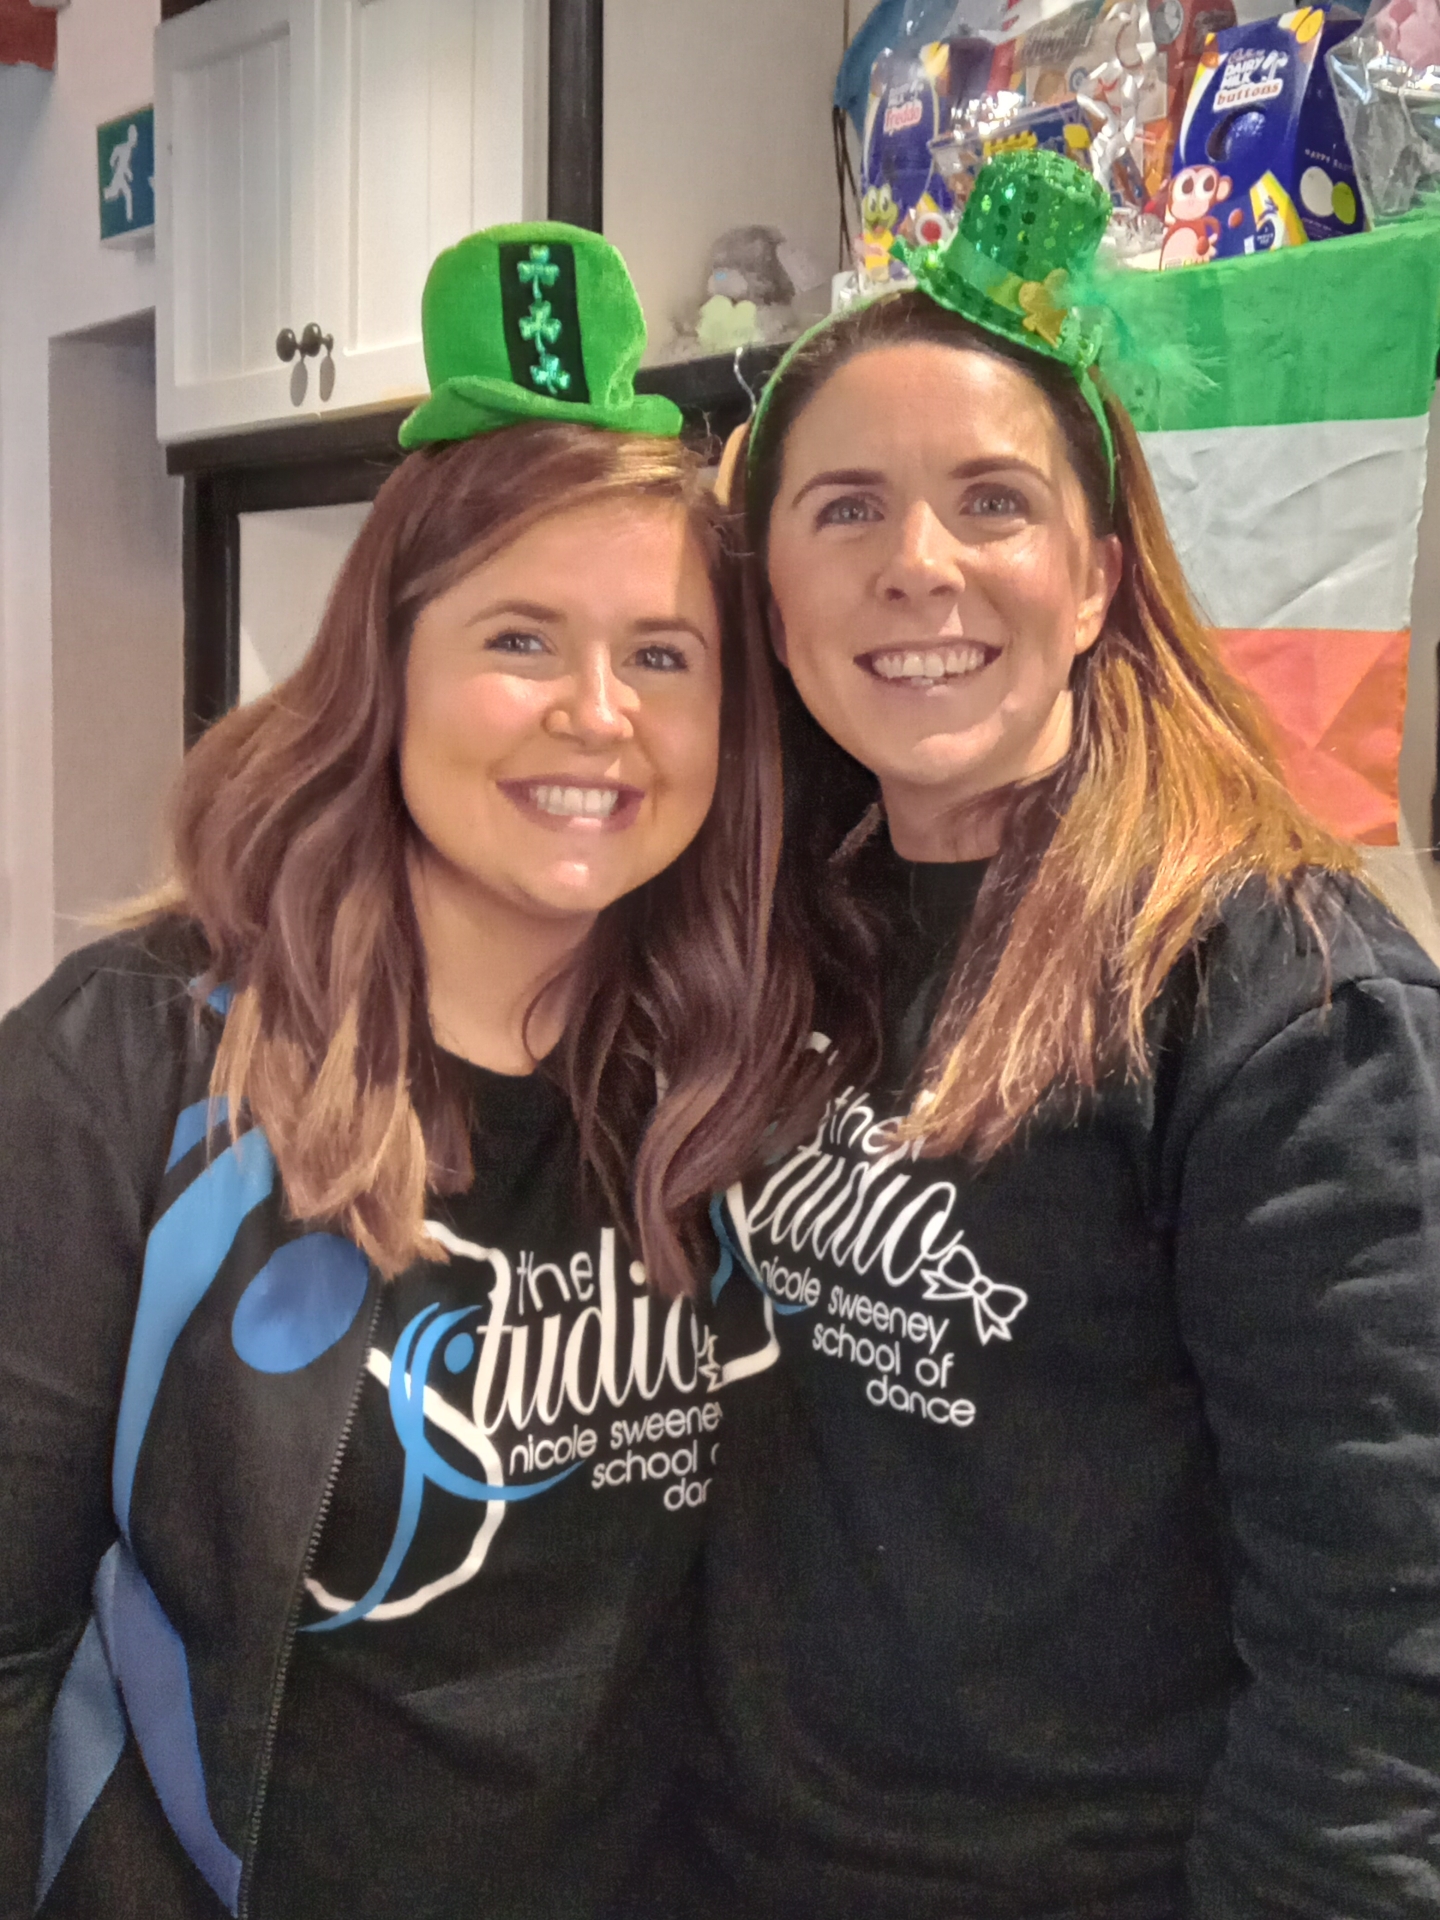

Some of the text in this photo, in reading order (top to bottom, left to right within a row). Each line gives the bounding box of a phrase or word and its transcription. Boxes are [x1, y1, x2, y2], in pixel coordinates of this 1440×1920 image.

[1217, 82, 1280, 106] buttons
[829, 1086, 908, 1155] the
[516, 1250, 595, 1316] the
[760, 1255, 951, 1355] nicole sweeney
[812, 1322, 955, 1389] school of
[866, 1374, 977, 1427] dance
[509, 1402, 722, 1476] nicole sweene
[592, 1440, 698, 1490] school
